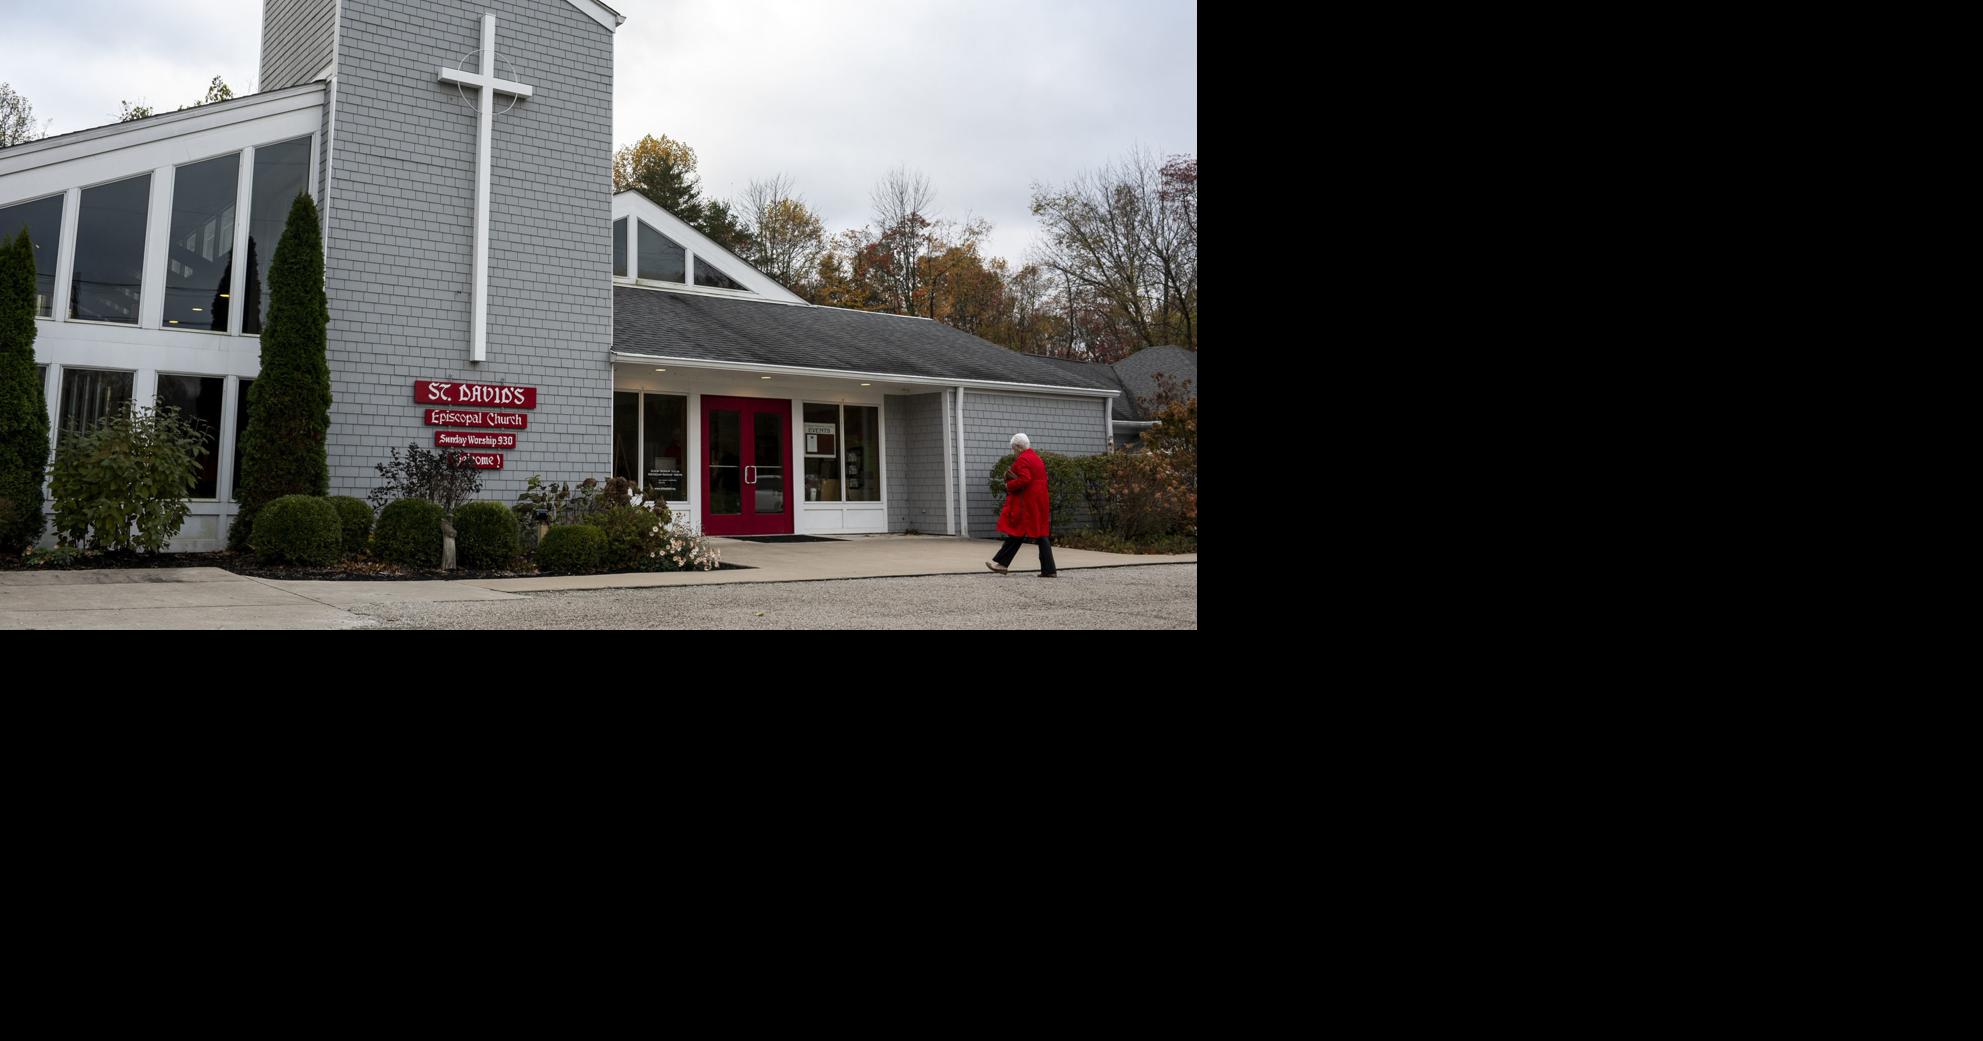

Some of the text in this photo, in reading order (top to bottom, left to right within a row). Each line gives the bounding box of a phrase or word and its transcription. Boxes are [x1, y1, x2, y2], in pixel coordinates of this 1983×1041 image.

[428, 382, 525, 405] ST. DAVID'S
[431, 410, 522, 426] Episcopal Church
[439, 433, 513, 447] Sunday Worship 930
